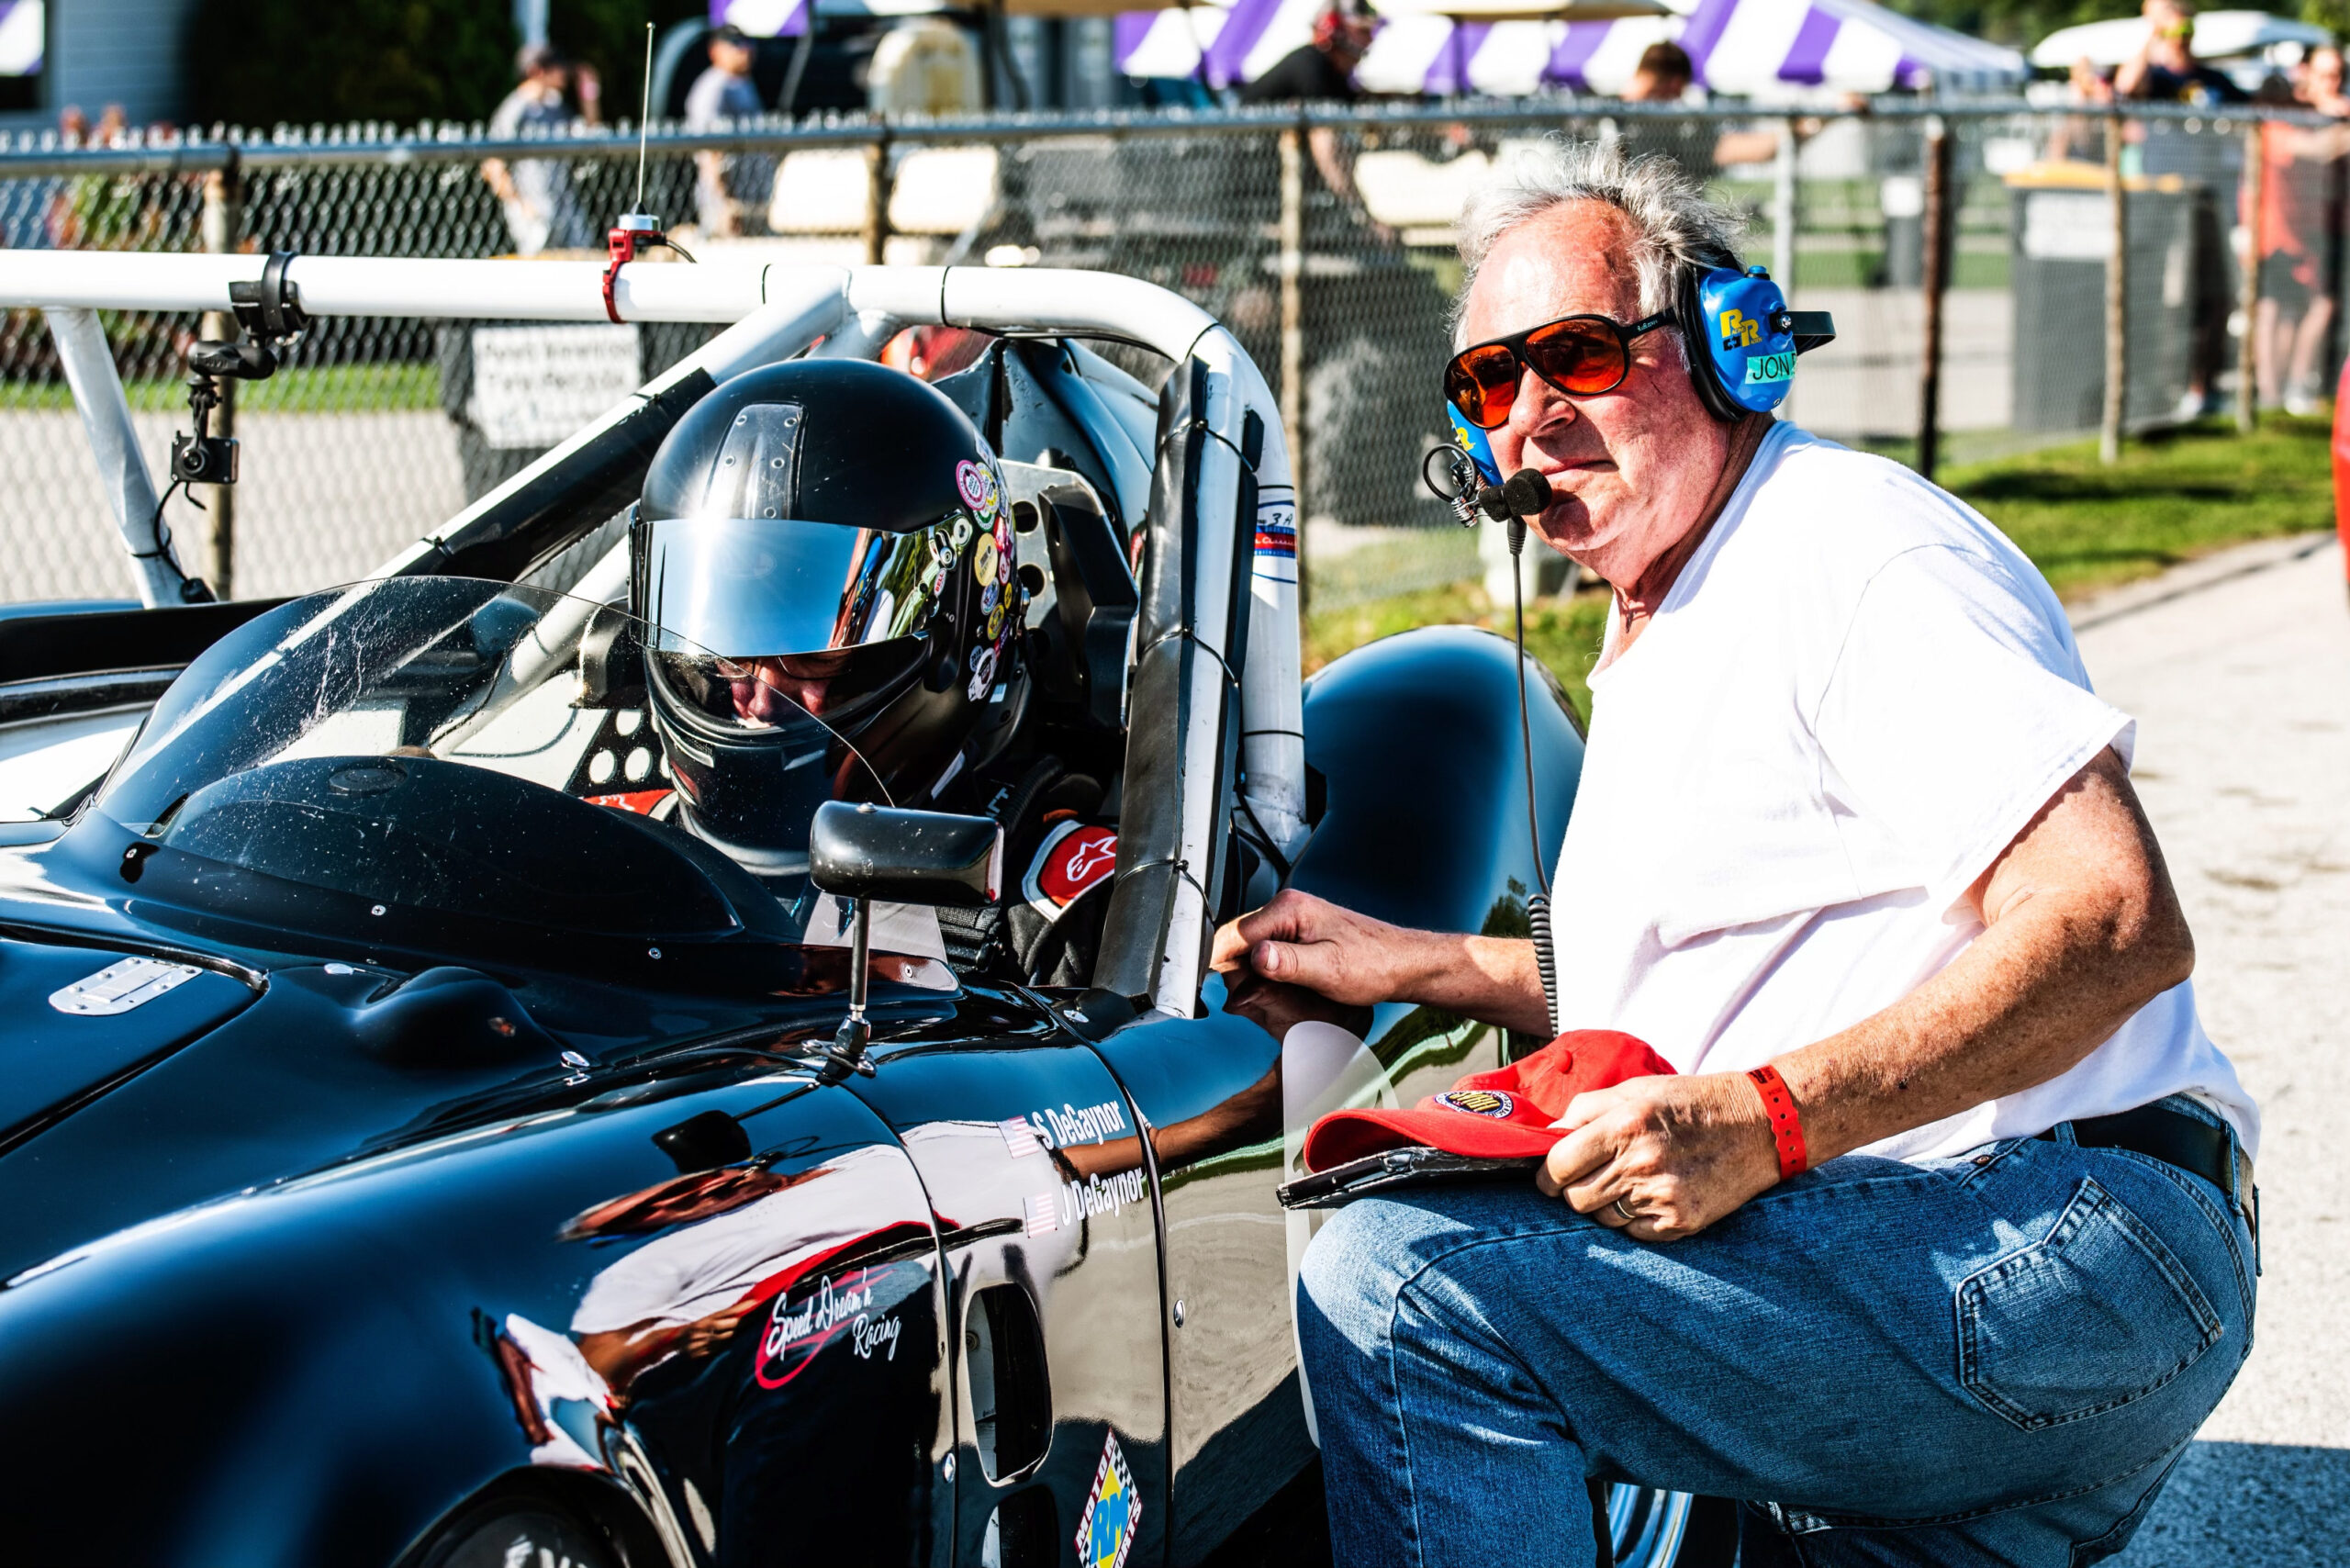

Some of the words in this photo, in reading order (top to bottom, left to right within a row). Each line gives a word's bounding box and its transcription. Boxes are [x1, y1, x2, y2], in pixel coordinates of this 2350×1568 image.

[934, 573, 944, 592] BELL
[1032, 1112, 1054, 1150] S
[1044, 1101, 1126, 1146] DeGaynor
[1061, 1184, 1071, 1226] J
[1070, 1167, 1144, 1217] DeGaynor
[766, 1293, 813, 1361] Speed
[853, 1313, 901, 1361] Racing
[1075, 1431, 1114, 1551] MOTOR
[1090, 1485, 1130, 1565] RM
[1113, 1497, 1143, 1568] ORTS
